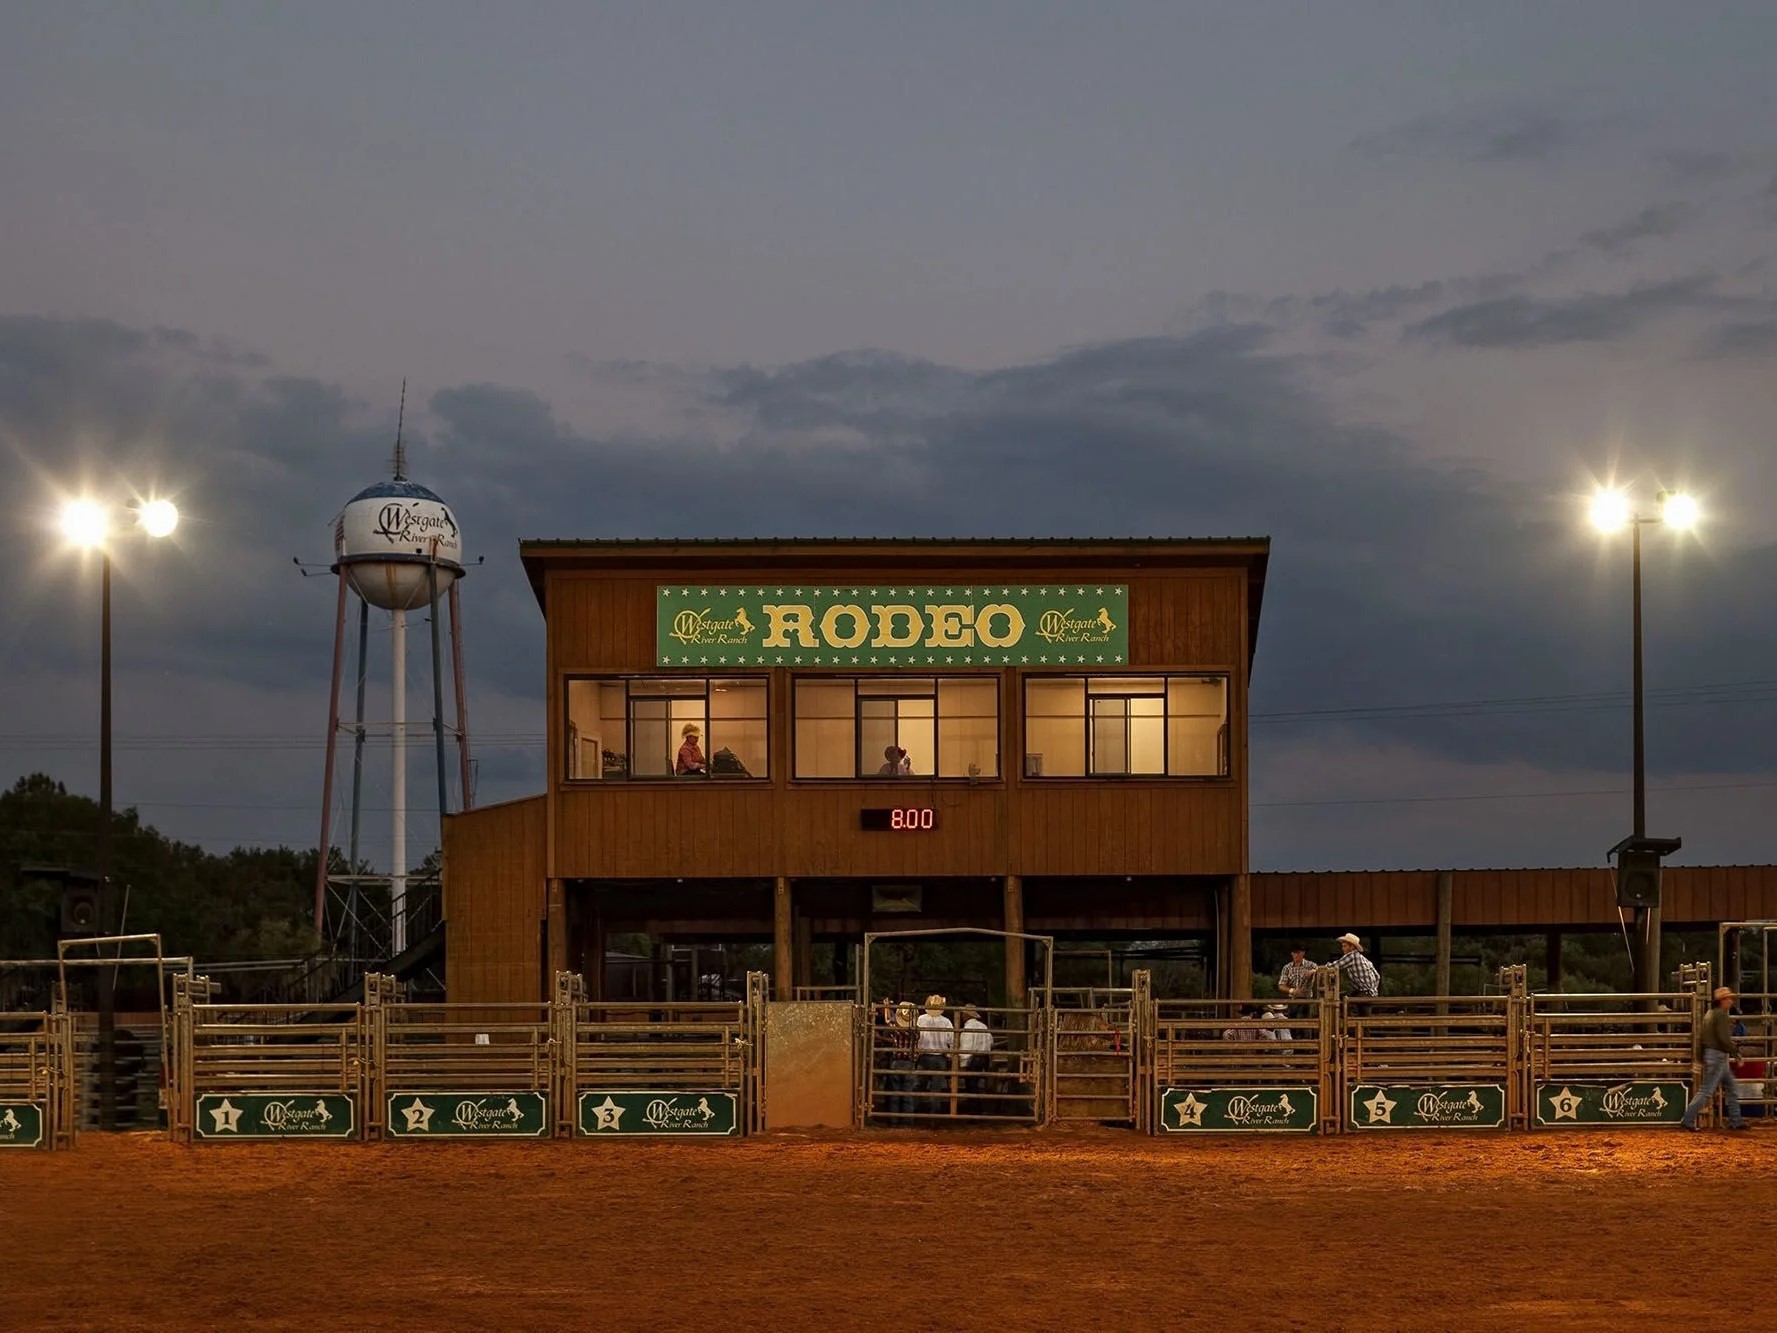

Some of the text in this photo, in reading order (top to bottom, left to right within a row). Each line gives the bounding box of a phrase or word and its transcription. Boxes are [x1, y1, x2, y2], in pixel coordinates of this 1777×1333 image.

[378, 503, 446, 534] Westgate
[399, 526, 428, 544] River
[674, 609, 734, 638] Westgate
[762, 604, 1026, 649] RODEO
[1040, 609, 1097, 638] Westgate
[690, 633, 748, 645] River Ranch
[1055, 632, 1110, 643] River Ranch
[891, 809, 933, 829] 8.00
[1227, 1095, 1279, 1120] Westgate
[1374, 1101, 1387, 1117] 5
[1417, 1092, 1467, 1117] Westgate
[1559, 1097, 1572, 1113] 6
[1602, 1089, 1651, 1113] Westgate
[221, 1110, 233, 1126] 1
[264, 1101, 315, 1126] Westgate
[411, 1109, 425, 1125] 2
[455, 1100, 507, 1125] Westgate
[602, 1108, 616, 1124] 3
[646, 1099, 698, 1124] Westgate
[1183, 1103, 1197, 1119] 4
[1431, 1111, 1479, 1121] River Ranch
[1616, 1108, 1663, 1118] River Ranch
[278, 1120, 327, 1131] River Ranch
[469, 1119, 518, 1130] River Ranch
[660, 1119, 709, 1129] River Ranch
[1242, 1114, 1290, 1125] River Ranch
